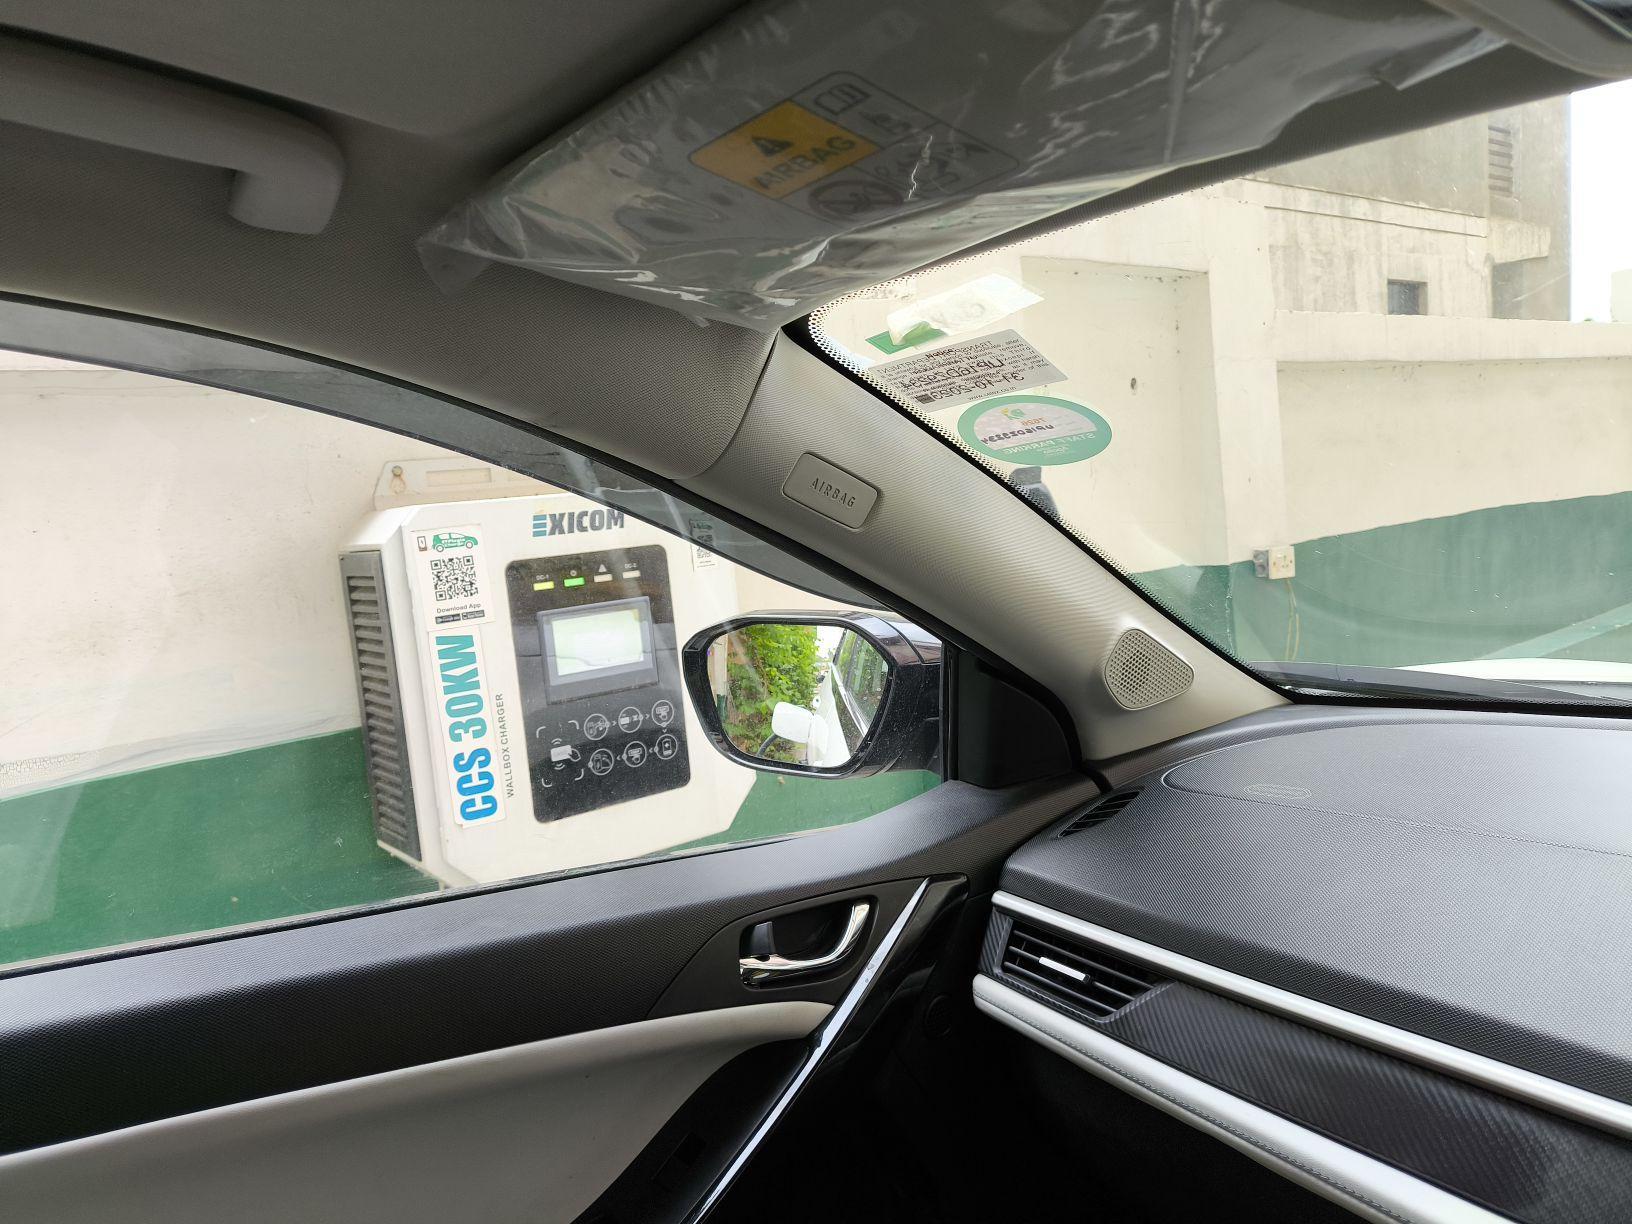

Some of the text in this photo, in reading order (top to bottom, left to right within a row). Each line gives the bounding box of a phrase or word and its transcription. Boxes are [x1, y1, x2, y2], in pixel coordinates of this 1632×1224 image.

[754, 136, 857, 189] AIRBAG
[811, 477, 856, 508] AIRBAG
[532, 508, 625, 538] EXICOM
[436, 604, 468, 613] Download
[435, 634, 488, 743] 30KW
[495, 693, 514, 799] WALLBOX CHARGER
[453, 747, 498, 821] CCS
